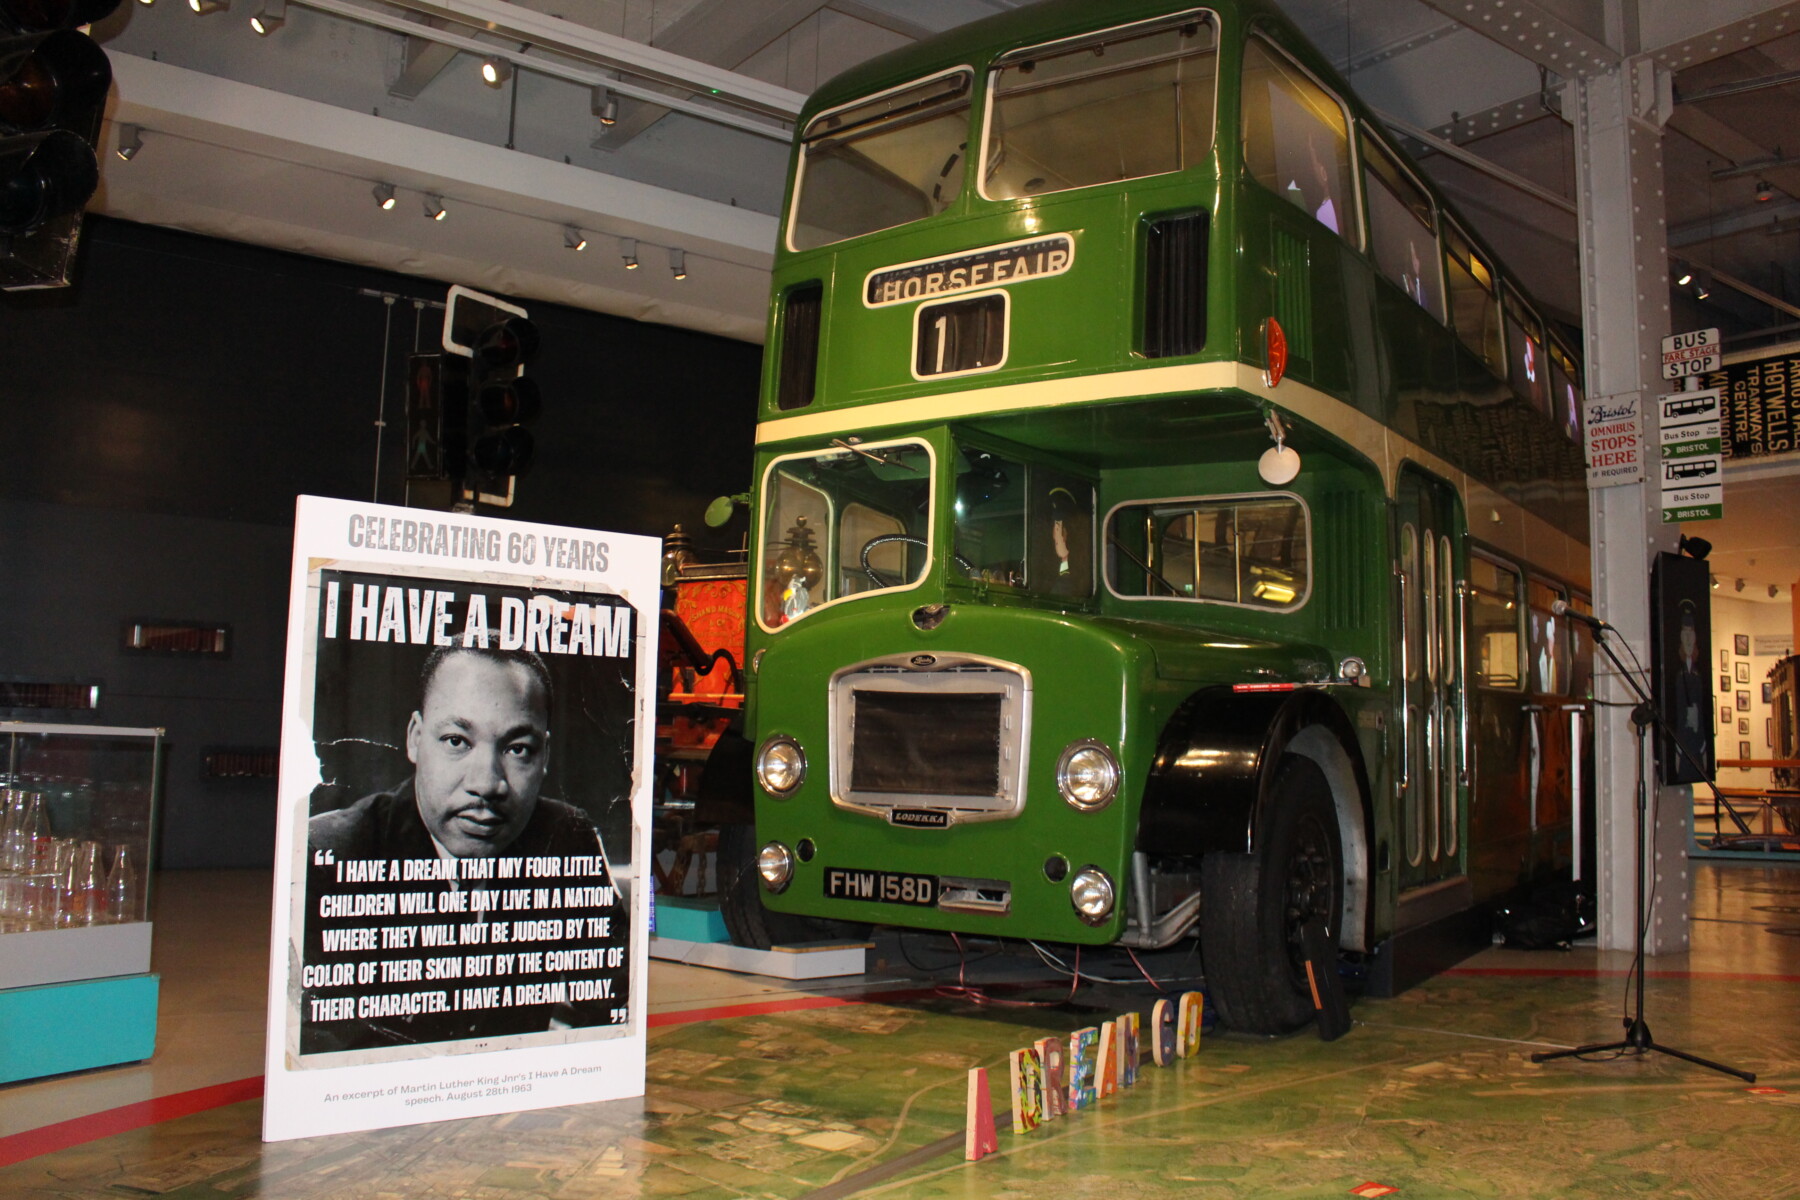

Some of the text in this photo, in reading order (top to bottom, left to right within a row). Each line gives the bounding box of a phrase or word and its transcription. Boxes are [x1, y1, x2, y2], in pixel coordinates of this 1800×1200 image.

[935, 315, 947, 372] 1
[1674, 331, 1707, 350] BUS
[1665, 345, 1717, 362] FARE STAGE
[1670, 357, 1712, 376] STOP
[1588, 400, 1637, 424] Bristol
[1734, 380, 1748, 443] CENTRE
[1747, 365, 1763, 454] TRAMWAYS
[1764, 361, 1789, 451] HOTWELLS
[1591, 422, 1635, 437] OMNIBUS
[1681, 430, 1700, 438] Stop
[1591, 434, 1637, 453] STOPS
[1676, 443, 1709, 453] BRISTOL
[1592, 450, 1637, 468] HERE
[1601, 466, 1638, 477] REQUIRED
[1674, 492, 1710, 502] Bus Stop
[1677, 509, 1710, 518] BRISTOL
[348, 513, 609, 573] CELEBRATING 60 YEARS
[324, 581, 631, 658] I HAVE A DREAM
[895, 812, 944, 824] LODEKKA
[346, 859, 386, 883] HAVE
[389, 859, 400, 882] A
[403, 858, 458, 881] DREAM
[461, 857, 495, 880] THAT
[498, 857, 523, 879] MY
[525, 856, 561, 878] FOUR
[563, 855, 603, 877] LITTLE
[830, 871, 932, 904] FHW 158D
[319, 886, 614, 918] CHILDREN WILL ONE DAY LIVE IN A NATION
[322, 917, 611, 952] WHERE THEY WILL NOT BE JUDGED BY THE
[302, 947, 624, 988] COLOR OF THEIR SKIN BUT BY THE CONTENT OF
[310, 978, 615, 1022] THEIR CHARACTER. I HAVE A DREAM TODAY.
[324, 1064, 602, 1103] An excerpt of Martin Luther King Jnr's I Have A Dream
[446, 1089, 483, 1103] August
[485, 1085, 509, 1097] 28th
[511, 1083, 533, 1094] 1963
